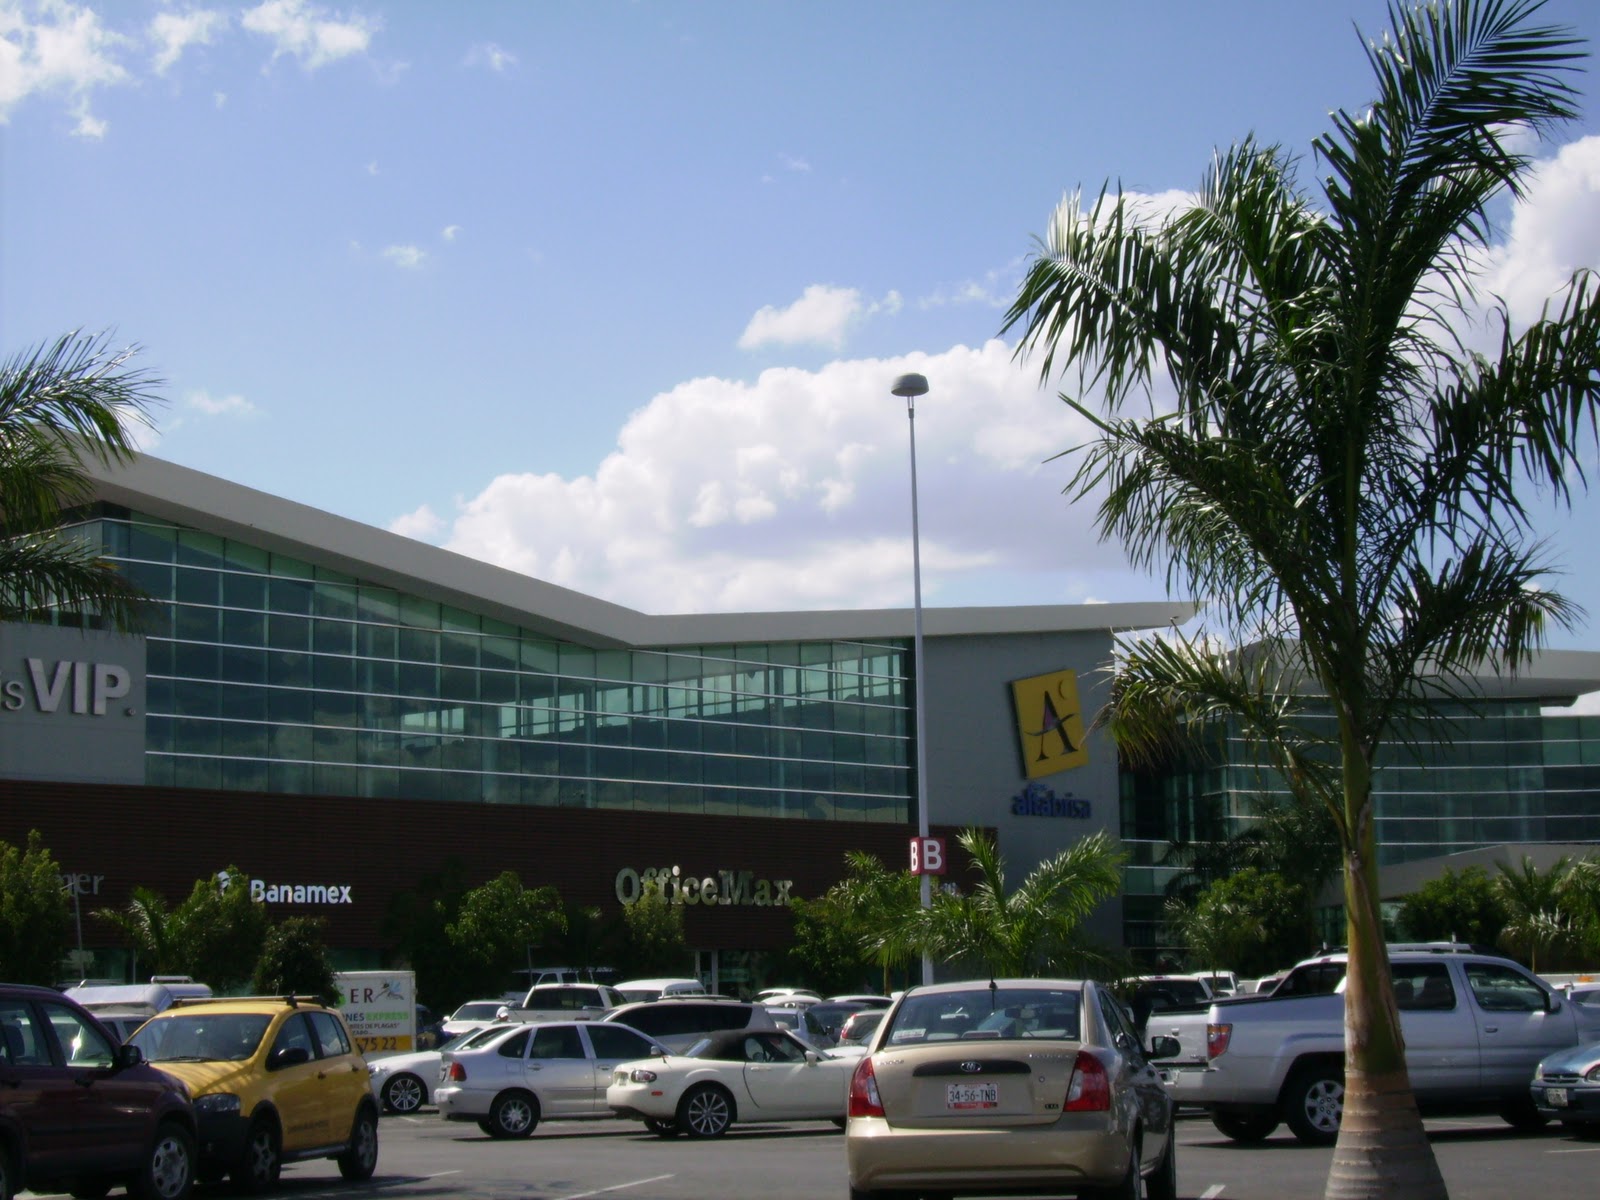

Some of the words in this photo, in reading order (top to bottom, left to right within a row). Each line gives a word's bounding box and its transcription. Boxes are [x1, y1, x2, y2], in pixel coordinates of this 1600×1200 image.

[26, 658, 131, 715] VIP
[911, 841, 918, 872] B
[923, 839, 942, 870] B
[250, 879, 353, 904] Banamex
[615, 865, 794, 907] OfficeMax
[344, 1012, 365, 1021] NES
